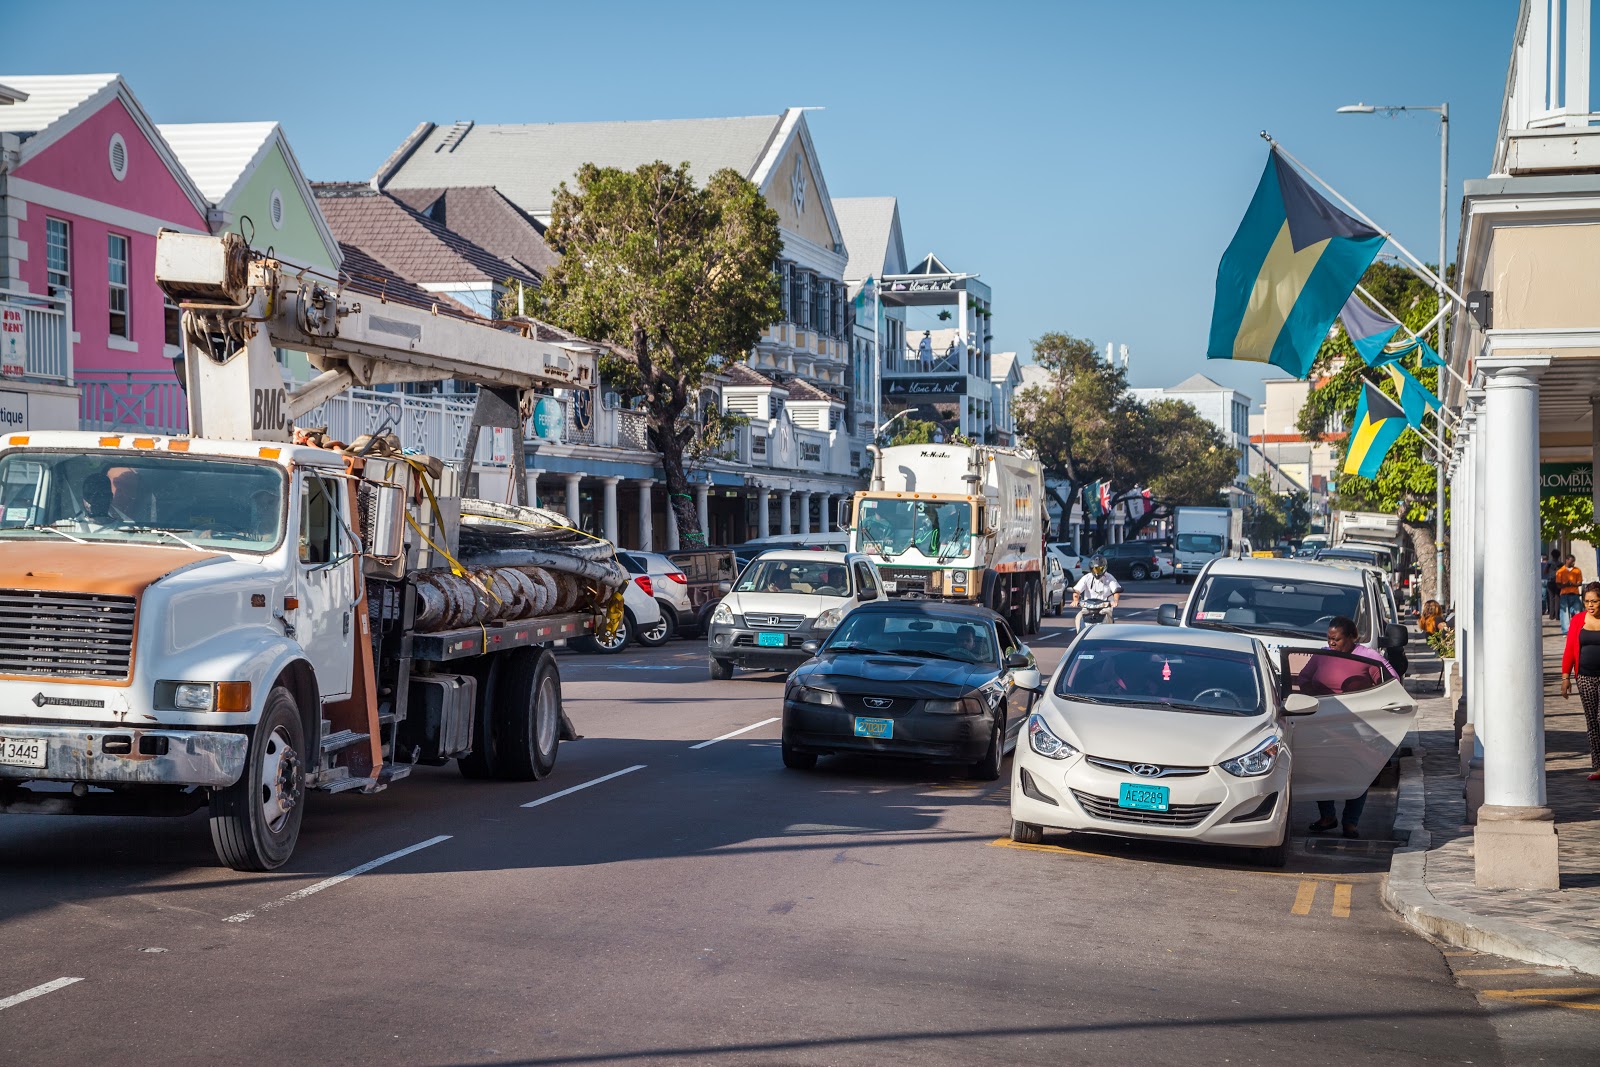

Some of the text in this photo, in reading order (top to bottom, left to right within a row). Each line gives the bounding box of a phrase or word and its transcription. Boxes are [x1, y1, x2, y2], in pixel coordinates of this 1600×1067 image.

[3, 310, 21, 321] FOR
[2, 321, 24, 333] RENT
[908, 382, 930, 393] blanc
[932, 383, 942, 392] du
[253, 388, 286, 430] BMC
[0, 407, 23, 426] tique
[1540, 474, 1593, 487] LOMBIA
[47, 697, 103, 707] INTERNATIONAL
[1125, 790, 1163, 804] AE3289
